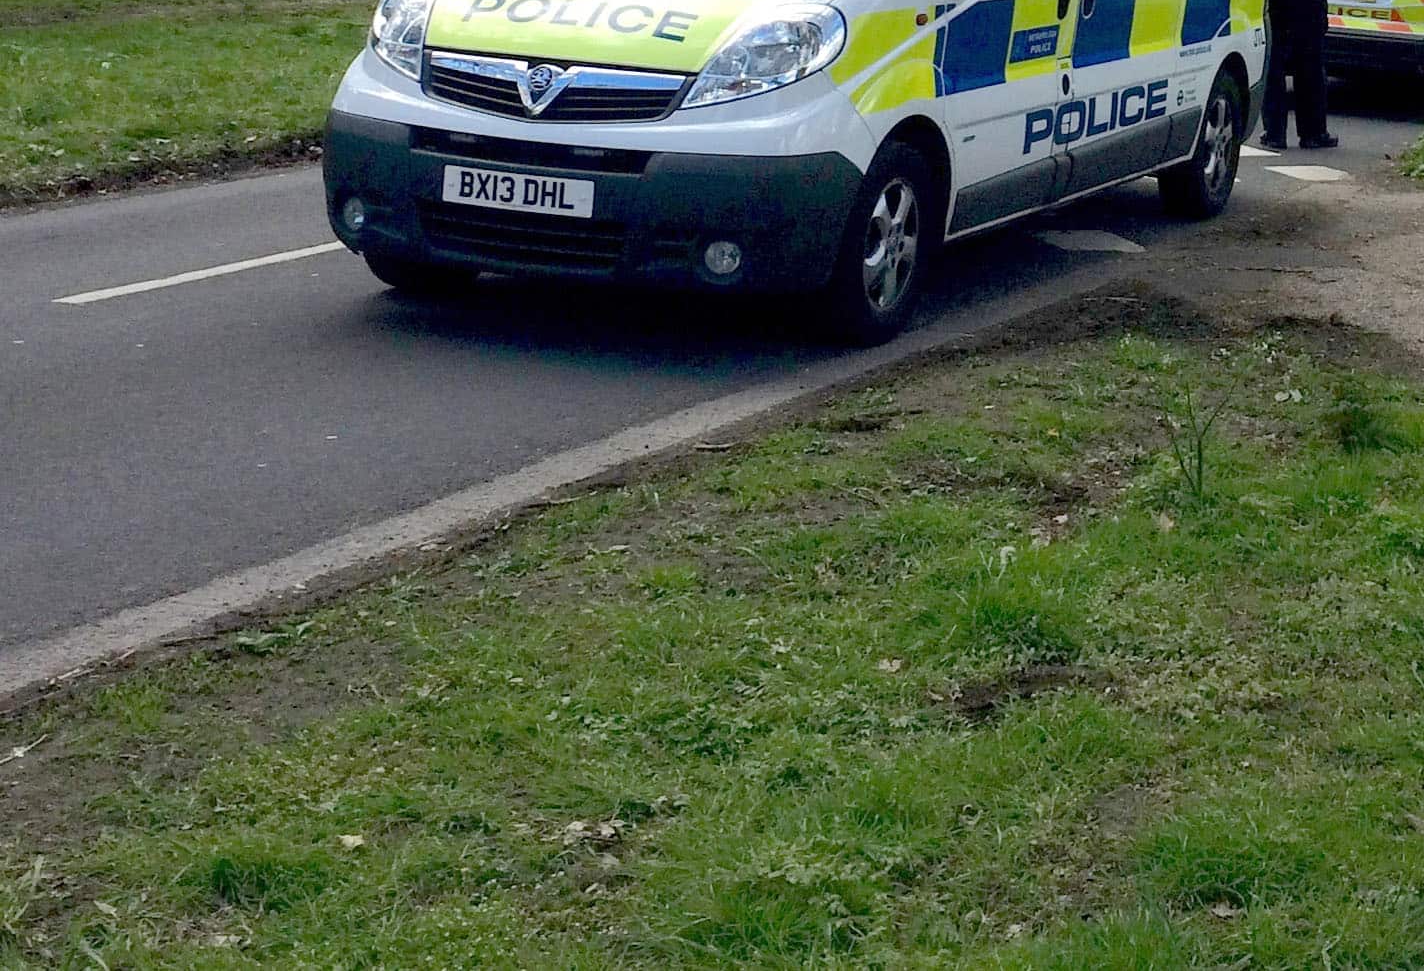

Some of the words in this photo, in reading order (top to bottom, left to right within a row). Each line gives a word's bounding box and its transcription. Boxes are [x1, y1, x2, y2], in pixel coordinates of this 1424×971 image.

[1022, 79, 1168, 155] POLICE
[459, 171, 515, 203] BX13
[523, 178, 575, 210] DHL
